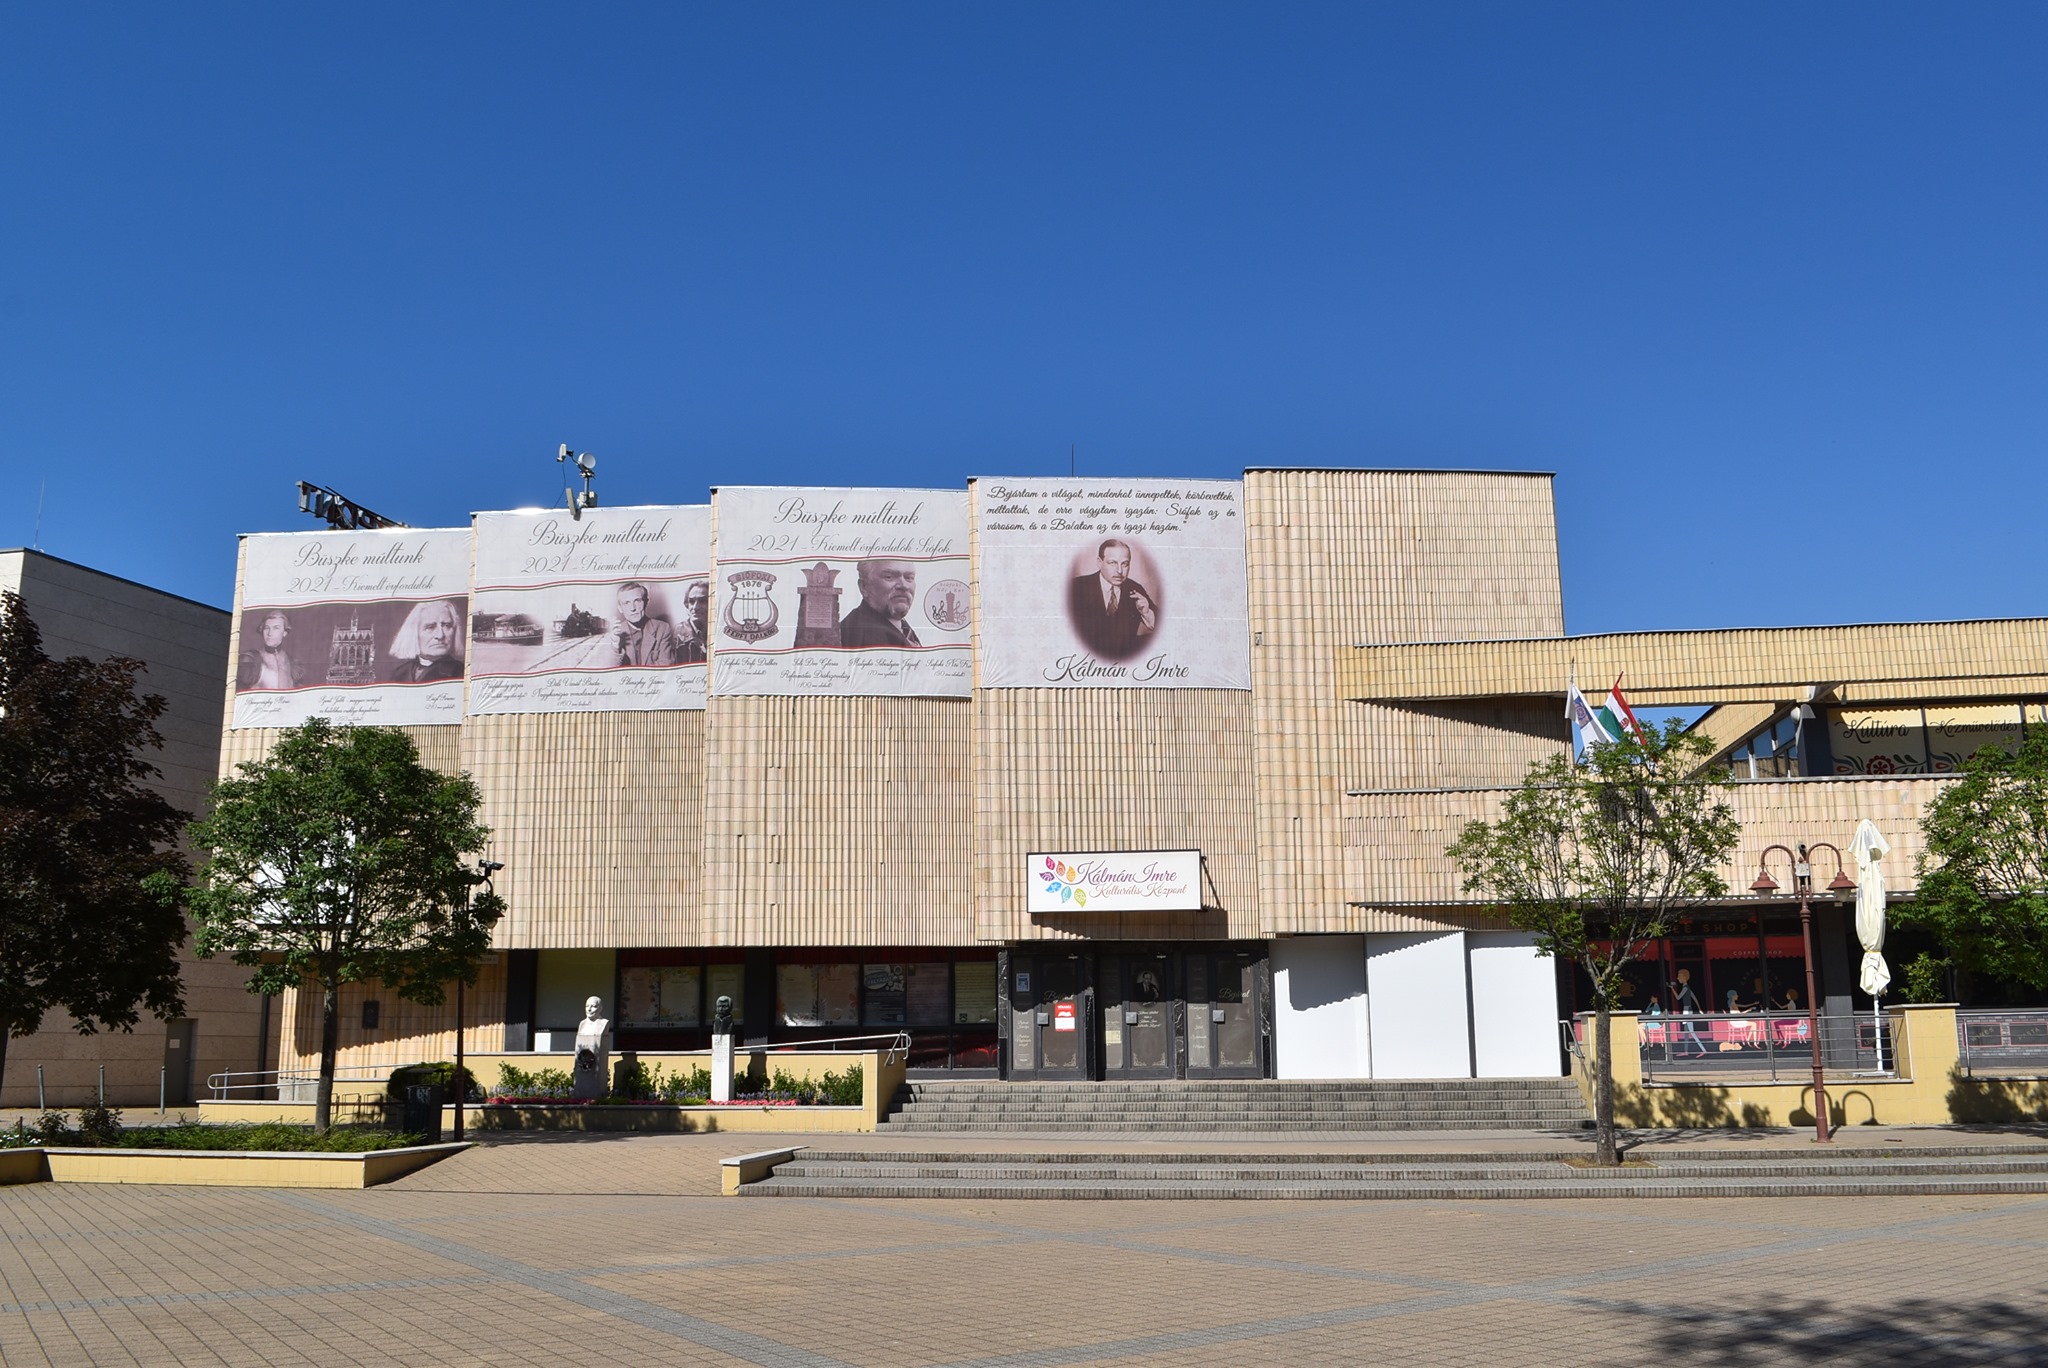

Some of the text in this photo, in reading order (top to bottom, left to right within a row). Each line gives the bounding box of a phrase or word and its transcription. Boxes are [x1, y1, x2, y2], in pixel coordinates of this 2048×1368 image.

[1087, 488, 1133, 499] mindenhol
[773, 496, 924, 537] Büszke múltunk
[1038, 505, 1049, 515] de
[1055, 507, 1073, 515] erre
[1079, 504, 1117, 520] vágytam
[1124, 505, 1159, 521] igazán:
[1165, 503, 1202, 521] Siófok
[1208, 509, 1220, 520] az
[1226, 506, 1236, 517] én
[528, 518, 670, 555] Büszke múltunk
[987, 520, 1025, 532] városom,
[1029, 521, 1038, 531] és
[1040, 523, 1047, 531] a
[1050, 518, 1094, 532] Balaton
[1096, 523, 1108, 534] az
[1111, 521, 1121, 531] én
[1123, 522, 1148, 534] igazi
[747, 534, 797, 552] 2021
[811, 533, 859, 552] Kiemelt
[859, 535, 912, 557] évfordulók
[916, 537, 950, 561] Siófok
[294, 541, 429, 577] Büszke múltunk
[521, 555, 570, 573] 2021
[578, 553, 626, 571] Kiemelt
[626, 554, 680, 576] évfordulók
[286, 575, 333, 593] 2021
[341, 574, 385, 591] Kiemelt
[384, 575, 433, 596] évfordulók
[741, 580, 762, 588] 1876
[1043, 652, 1190, 682] Kálmán Imre
[1834, 716, 1910, 744] Kultúra
[1929, 717, 2018, 738] Közművelődés
[1074, 860, 1177, 885] Kálmán Imre
[1088, 881, 1187, 898] Kulturális Központ
[1703, 923, 1748, 933] SHOP
